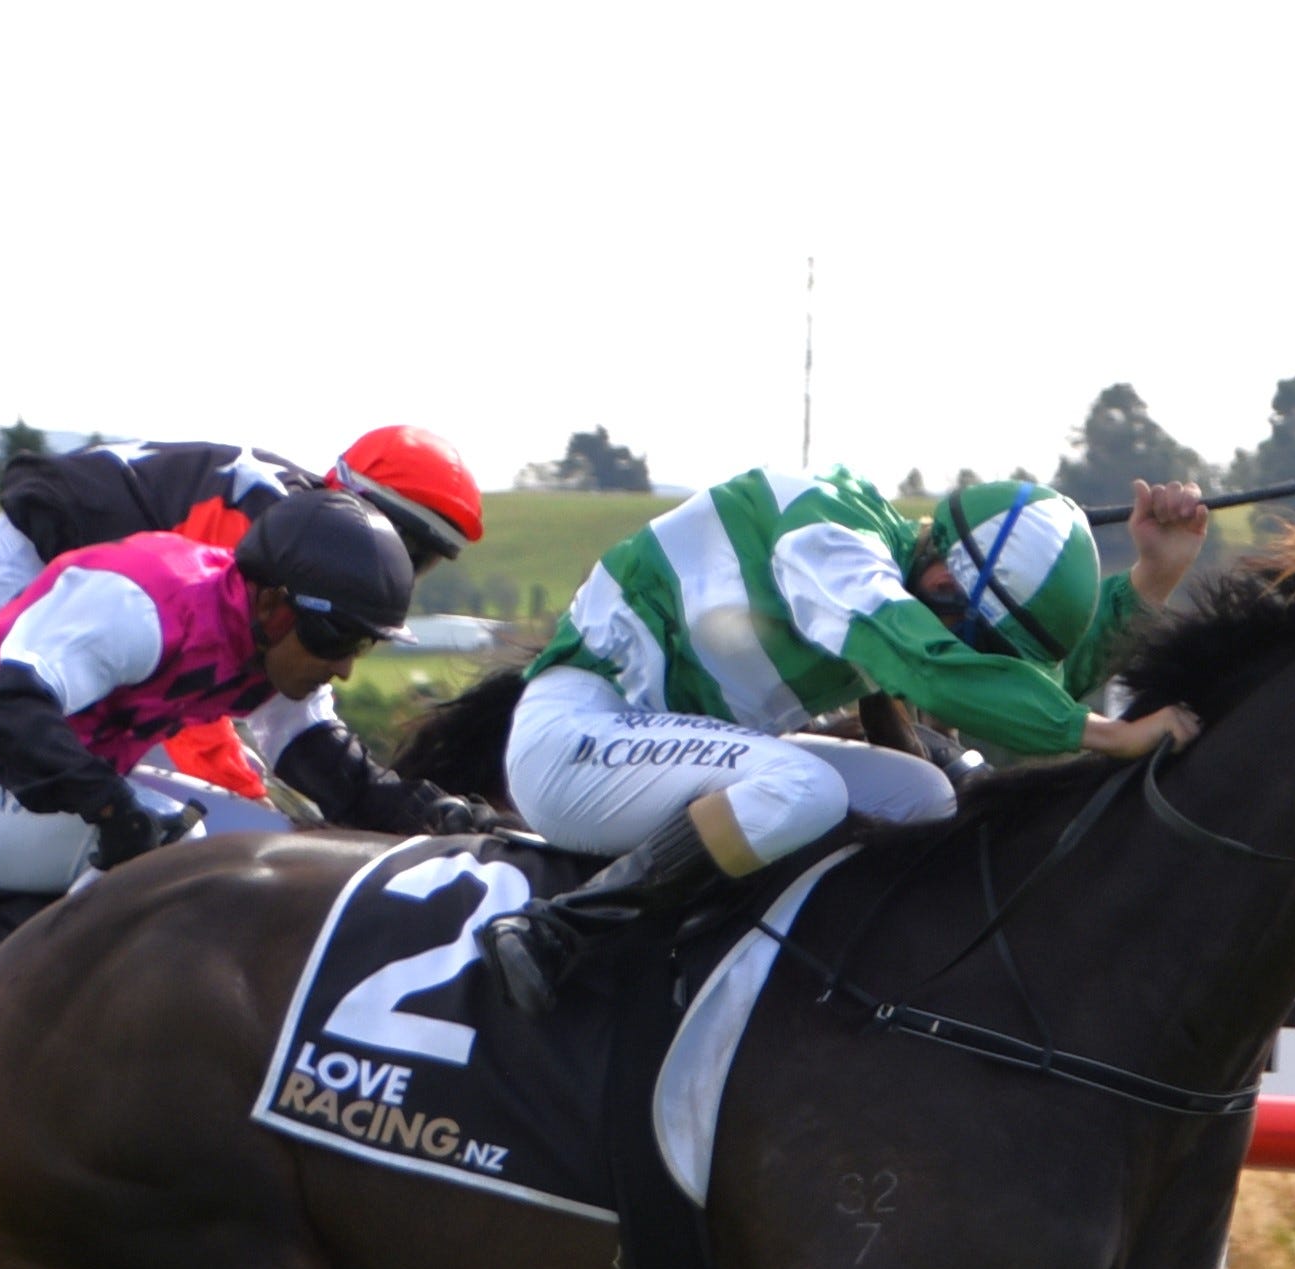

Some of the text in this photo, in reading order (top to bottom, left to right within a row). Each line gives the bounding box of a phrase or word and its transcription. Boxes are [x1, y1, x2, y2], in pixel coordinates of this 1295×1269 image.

[323, 851, 531, 1066] 2
[278, 1071, 509, 1171] RACING.NZ
[295, 1041, 412, 1105] LOVE
